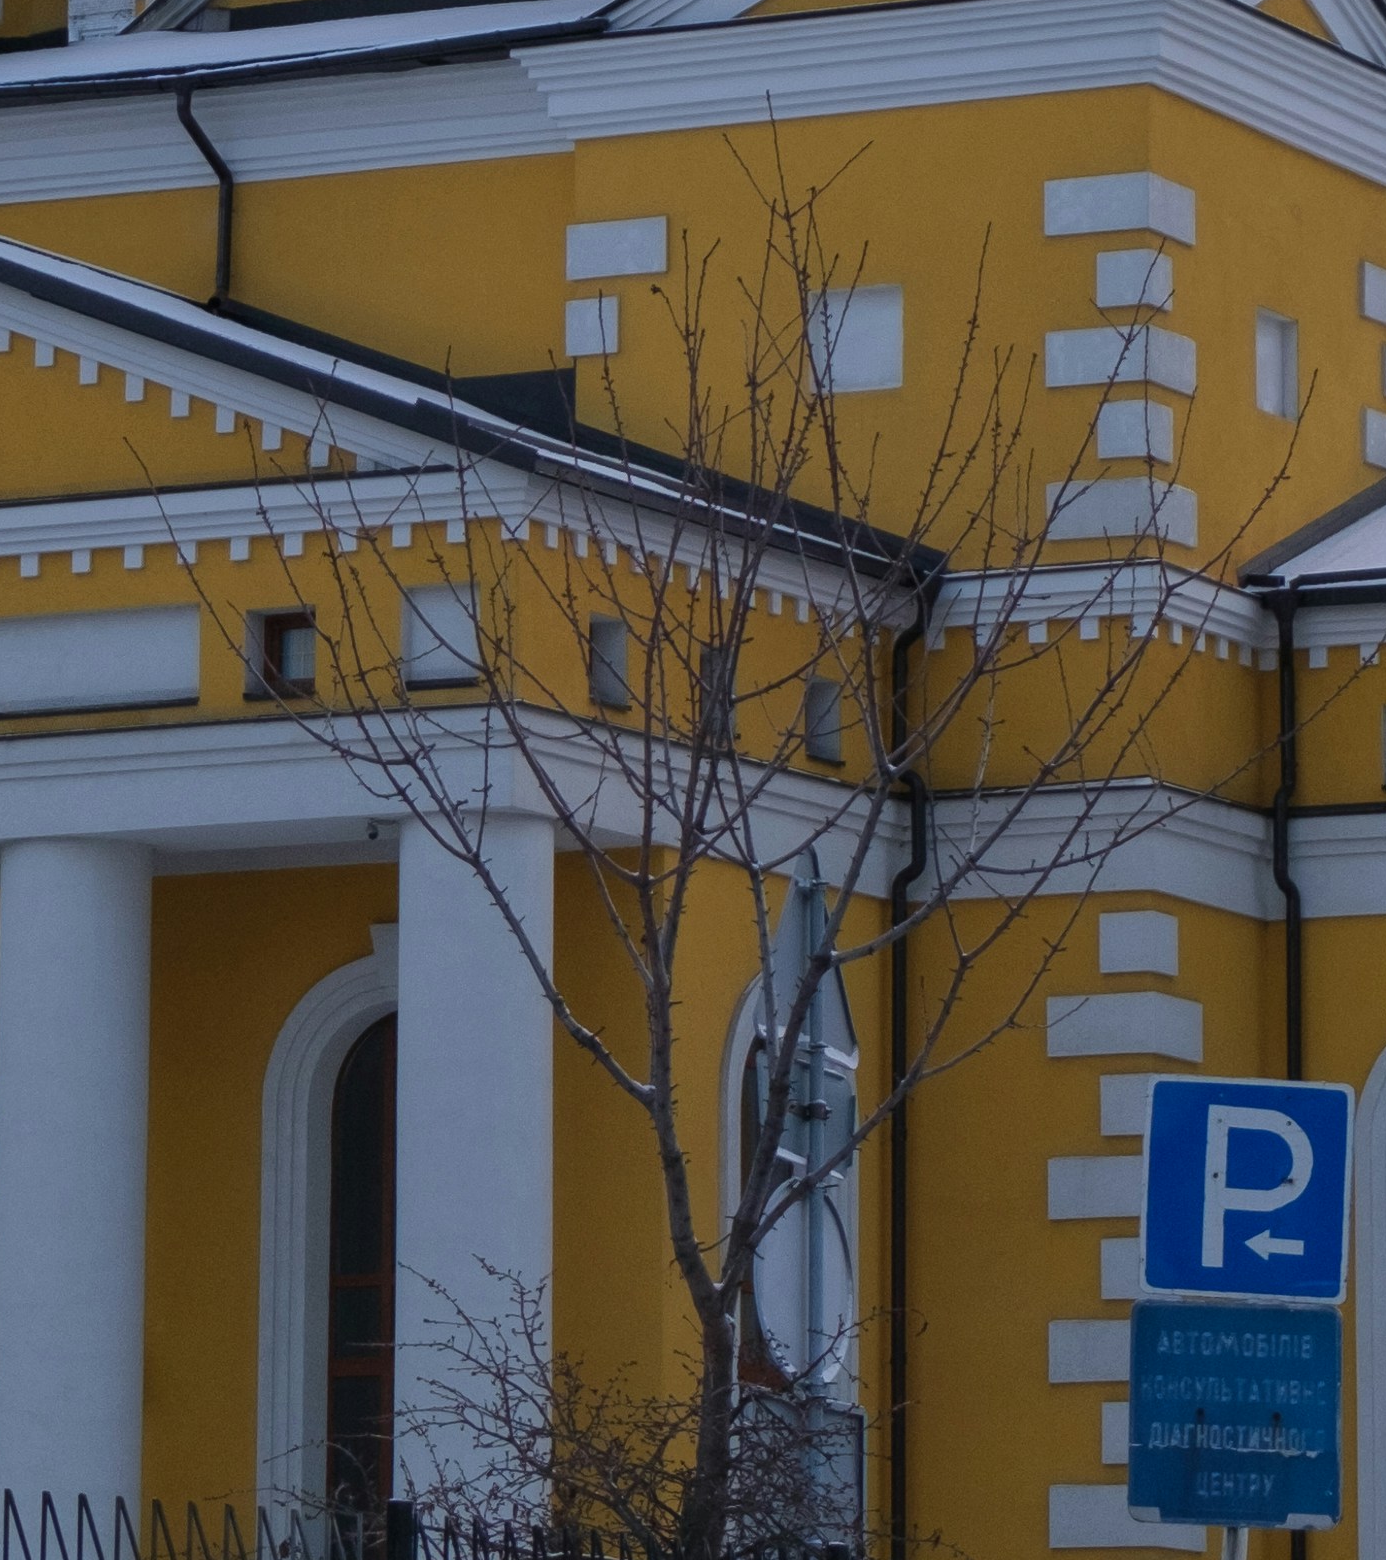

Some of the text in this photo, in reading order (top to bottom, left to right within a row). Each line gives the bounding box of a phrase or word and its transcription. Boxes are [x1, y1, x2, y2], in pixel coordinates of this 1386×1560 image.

[1201, 1103, 1314, 1268] P
[1156, 1330, 1313, 1360] АВТОМОБІЛІВ
[1196, 1471, 1276, 1498] ЦЕНТРУ
